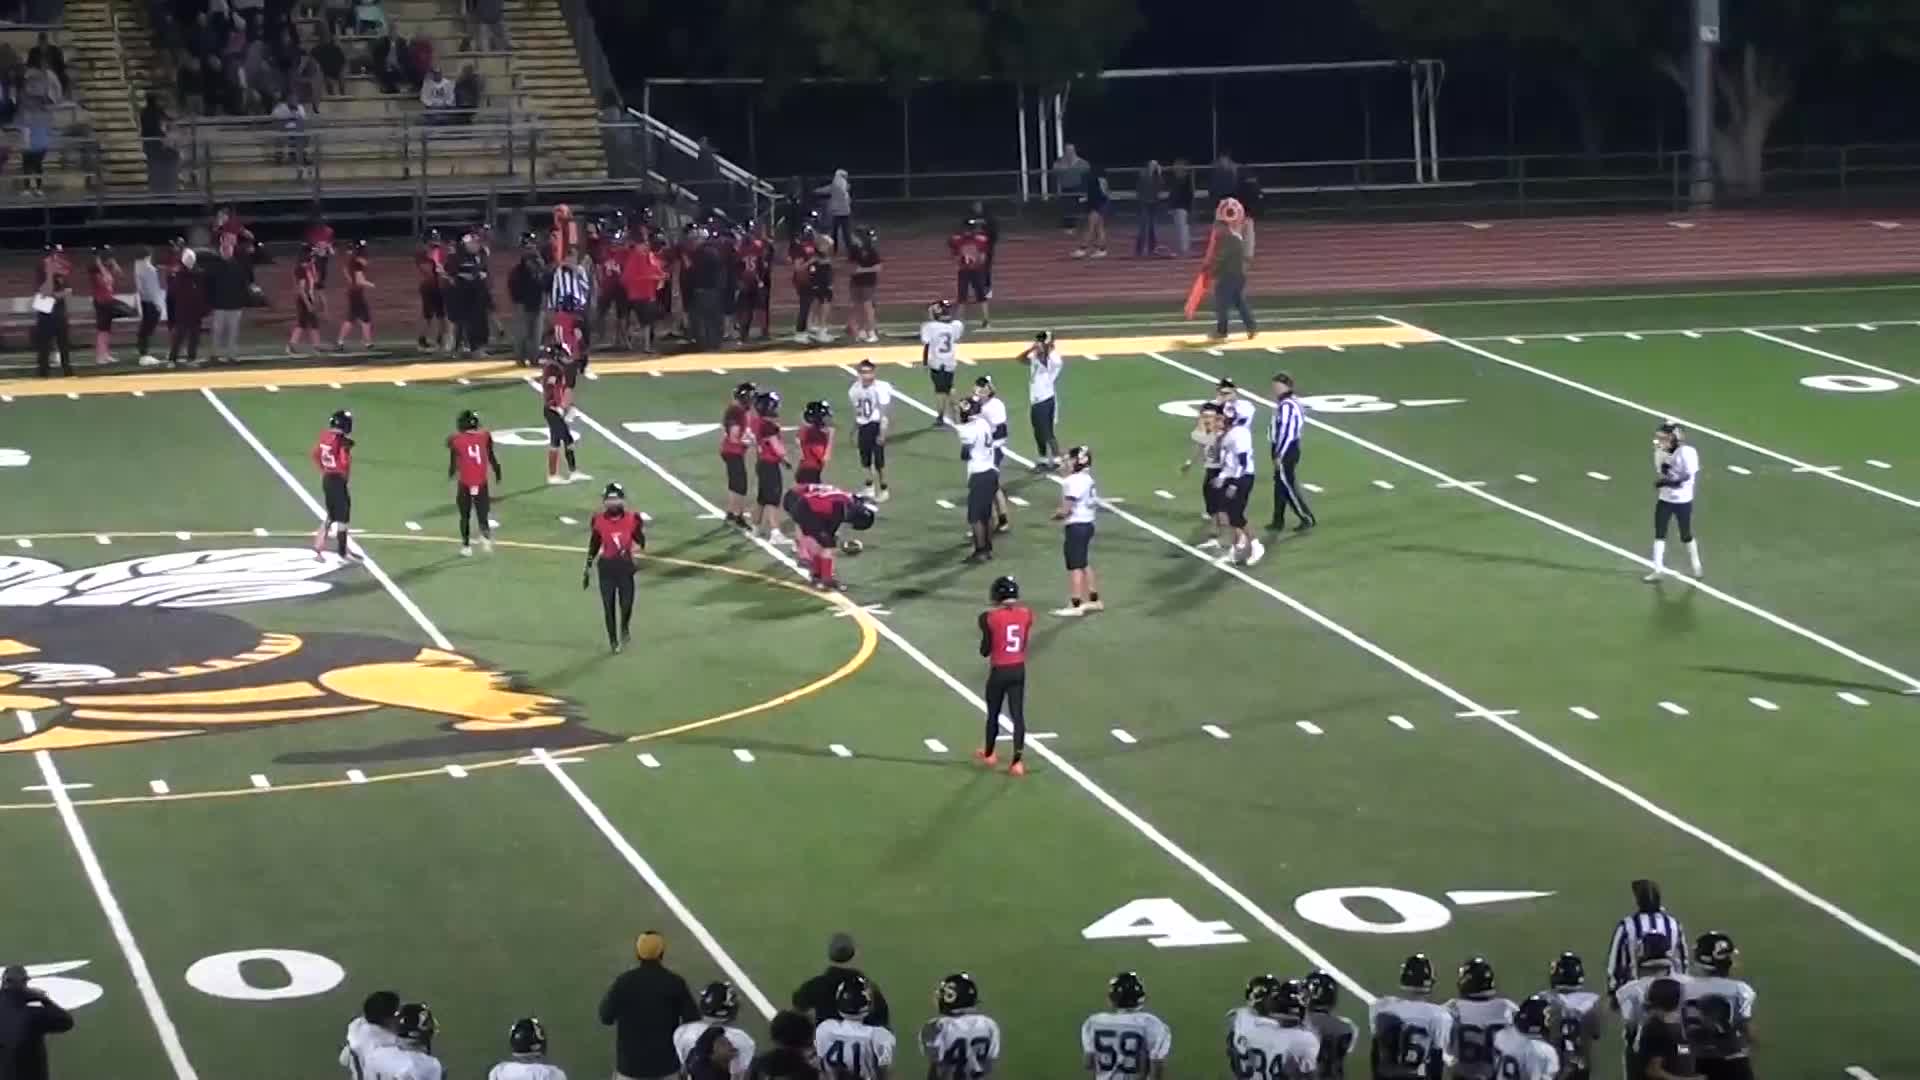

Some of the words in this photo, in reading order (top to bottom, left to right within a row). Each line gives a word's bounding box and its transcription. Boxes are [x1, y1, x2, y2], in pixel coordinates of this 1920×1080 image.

[938, 332, 952, 353] 3
[467, 443, 482, 464] 4
[1004, 623, 1022, 653] 5
[825, 1039, 862, 1075] 41
[1094, 1029, 1148, 1075] 59
